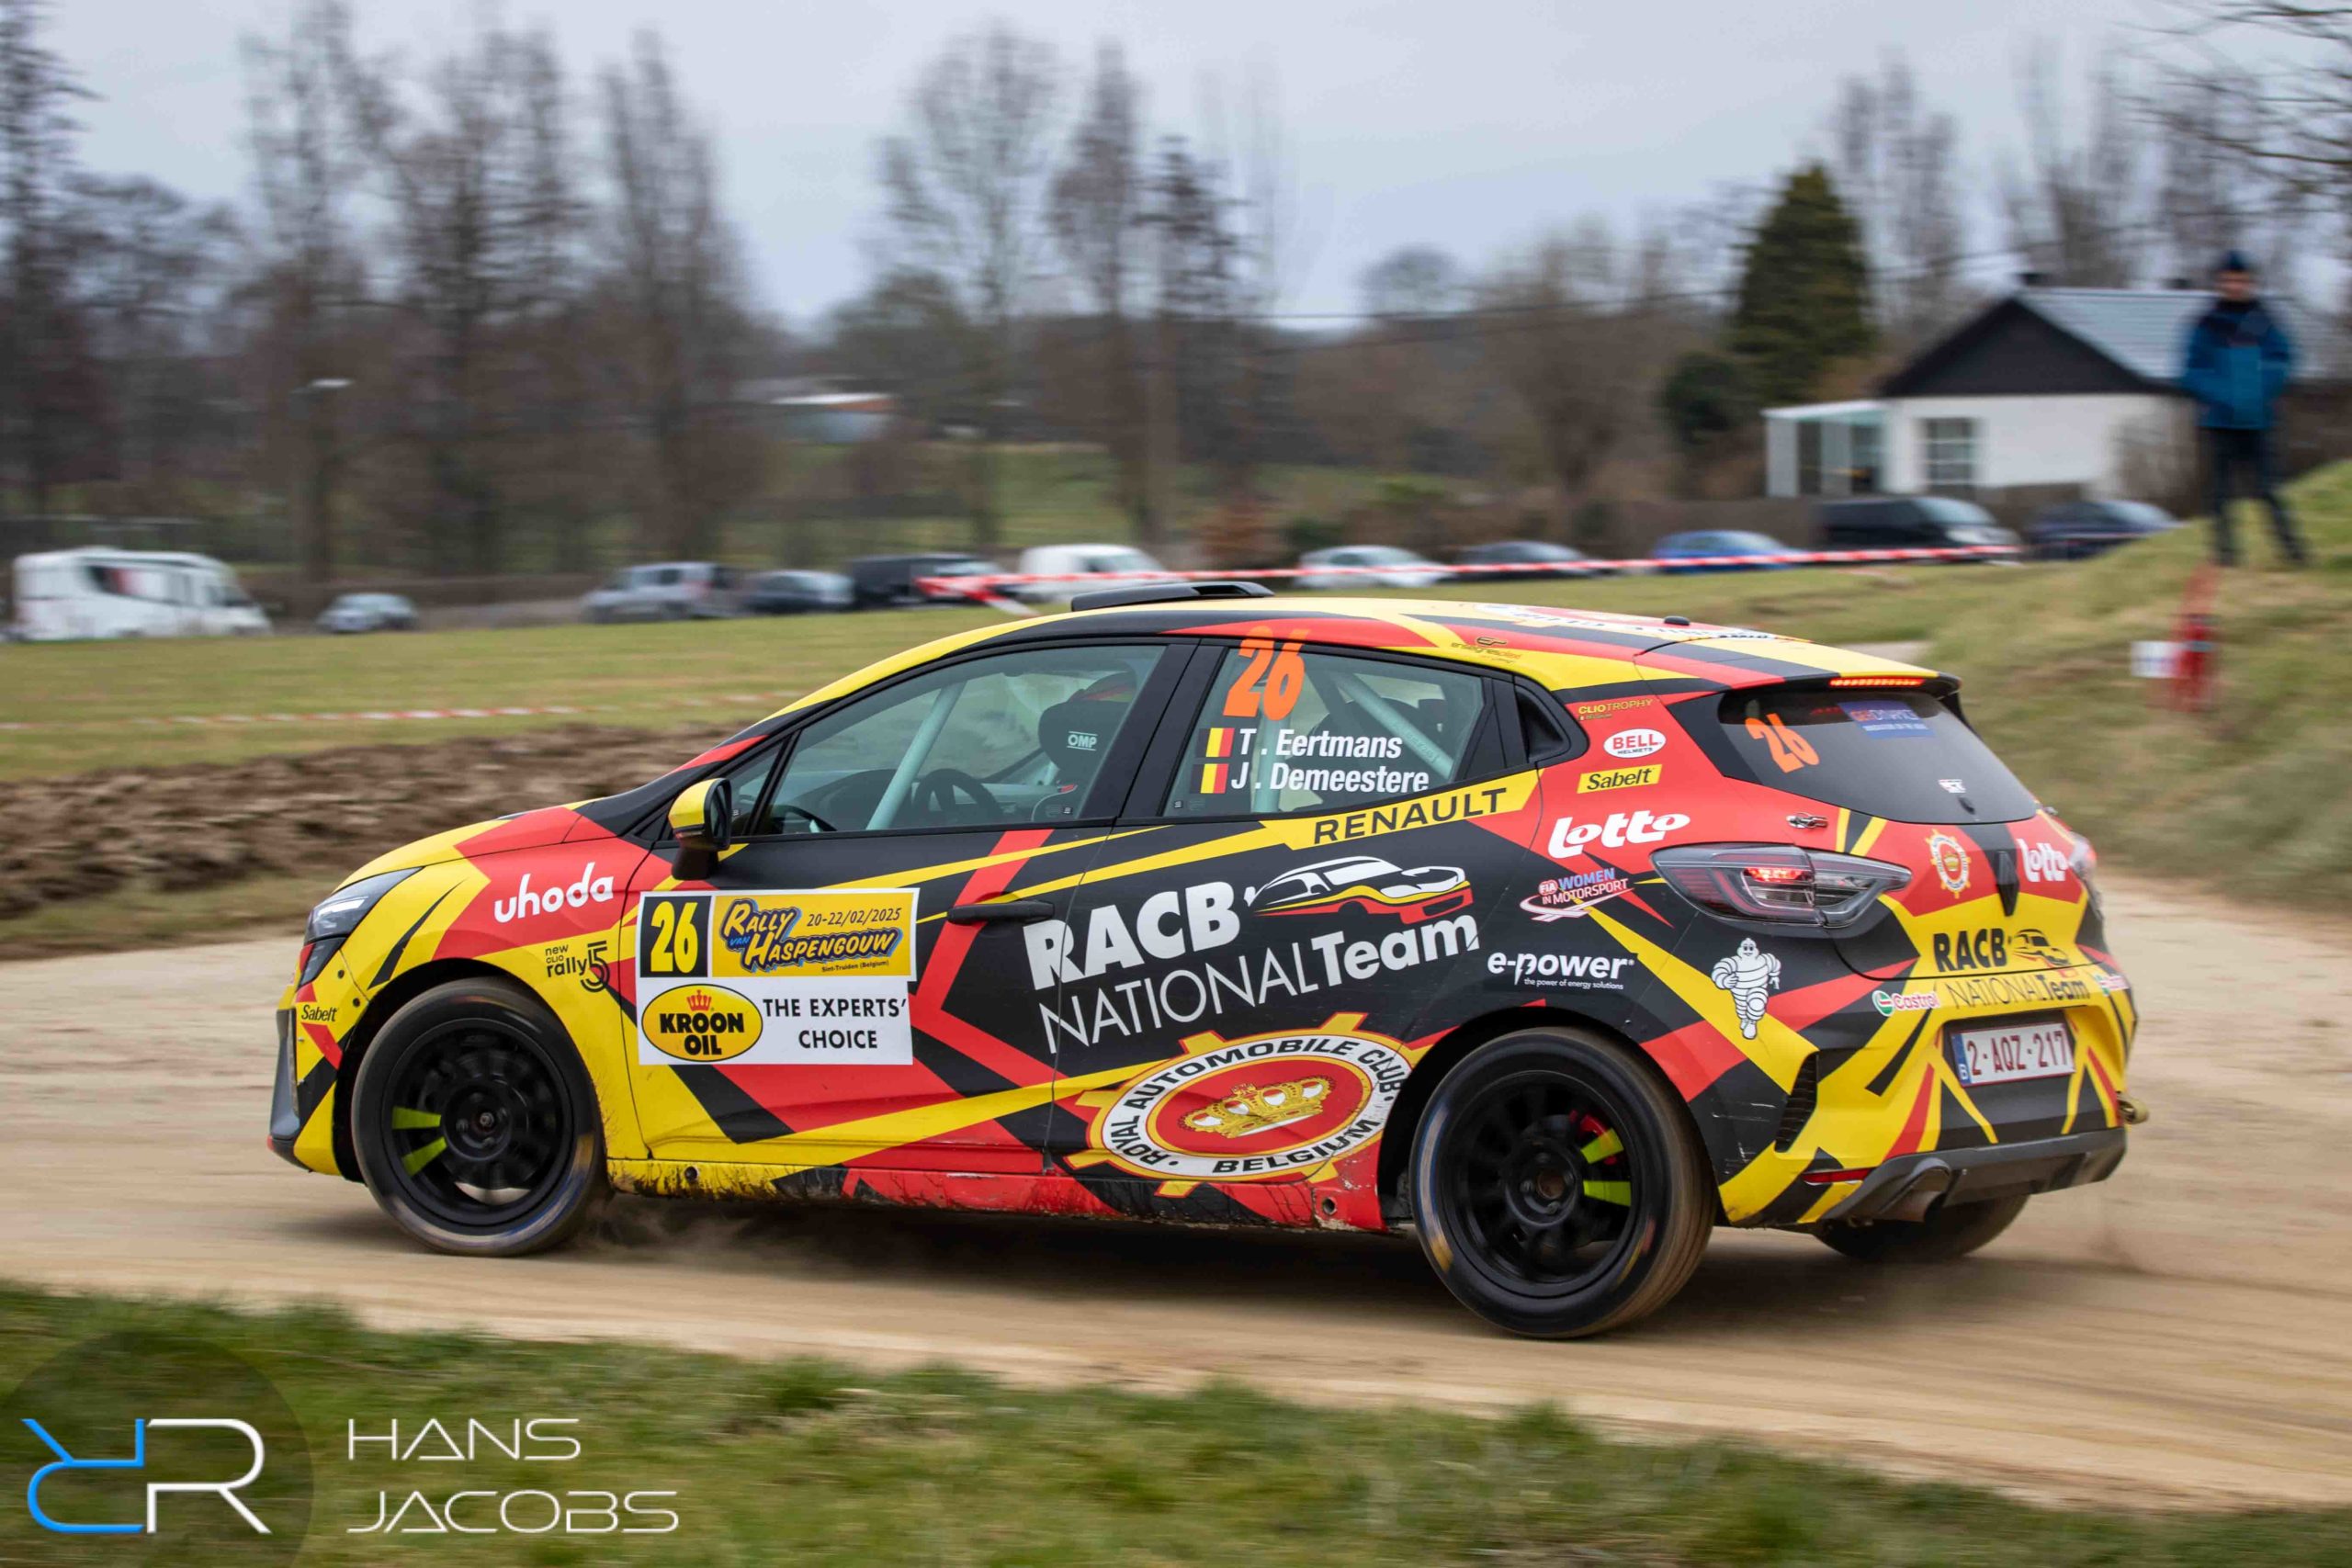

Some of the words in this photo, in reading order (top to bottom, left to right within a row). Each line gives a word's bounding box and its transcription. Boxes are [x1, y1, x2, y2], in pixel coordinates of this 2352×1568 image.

[1223, 626, 1311, 721] 26
[1068, 734, 1097, 749] OMP
[1275, 728, 1403, 760] Eertmans
[1612, 734, 1658, 750] BELL
[1745, 713, 1820, 773] 26
[1270, 762, 1430, 794] Demeestere
[1587, 768, 1652, 790] Sabelt
[1313, 787, 1508, 844] RENAULT
[494, 862, 614, 923] uhoda
[1538, 882, 1556, 893] FIA
[1558, 867, 1615, 890] WOMEN
[1543, 896, 1552, 905] IN
[1553, 878, 1628, 905] MOTORSPORT
[807, 908, 902, 927] 20-22/02/2025
[650, 901, 698, 974] 26
[745, 930, 897, 965] HASPENGOUW
[1023, 882, 1240, 989] RACB
[545, 944, 569, 956] new
[1933, 928, 2007, 972] RACB
[547, 956, 587, 978] rally
[1487, 952, 1628, 985] e-power
[1567, 981, 1591, 989] energy
[1592, 981, 1624, 989] solutions
[300, 1004, 337, 1021] Sabelt
[763, 998, 801, 1017] THE
[1893, 990, 1939, 1010] Castrol
[660, 1013, 745, 1034] KROON
[684, 1034, 722, 1055] OIL
[798, 1030, 877, 1049] CHOICE
[1124, 1038, 1360, 1110] AUTOMOBILE
[1358, 1048, 1402, 1094] CLUB
[1959, 1064, 1969, 1080] B
[1111, 1116, 1170, 1166] ROYAL
[1212, 1119, 1381, 1174] BELGIUM
